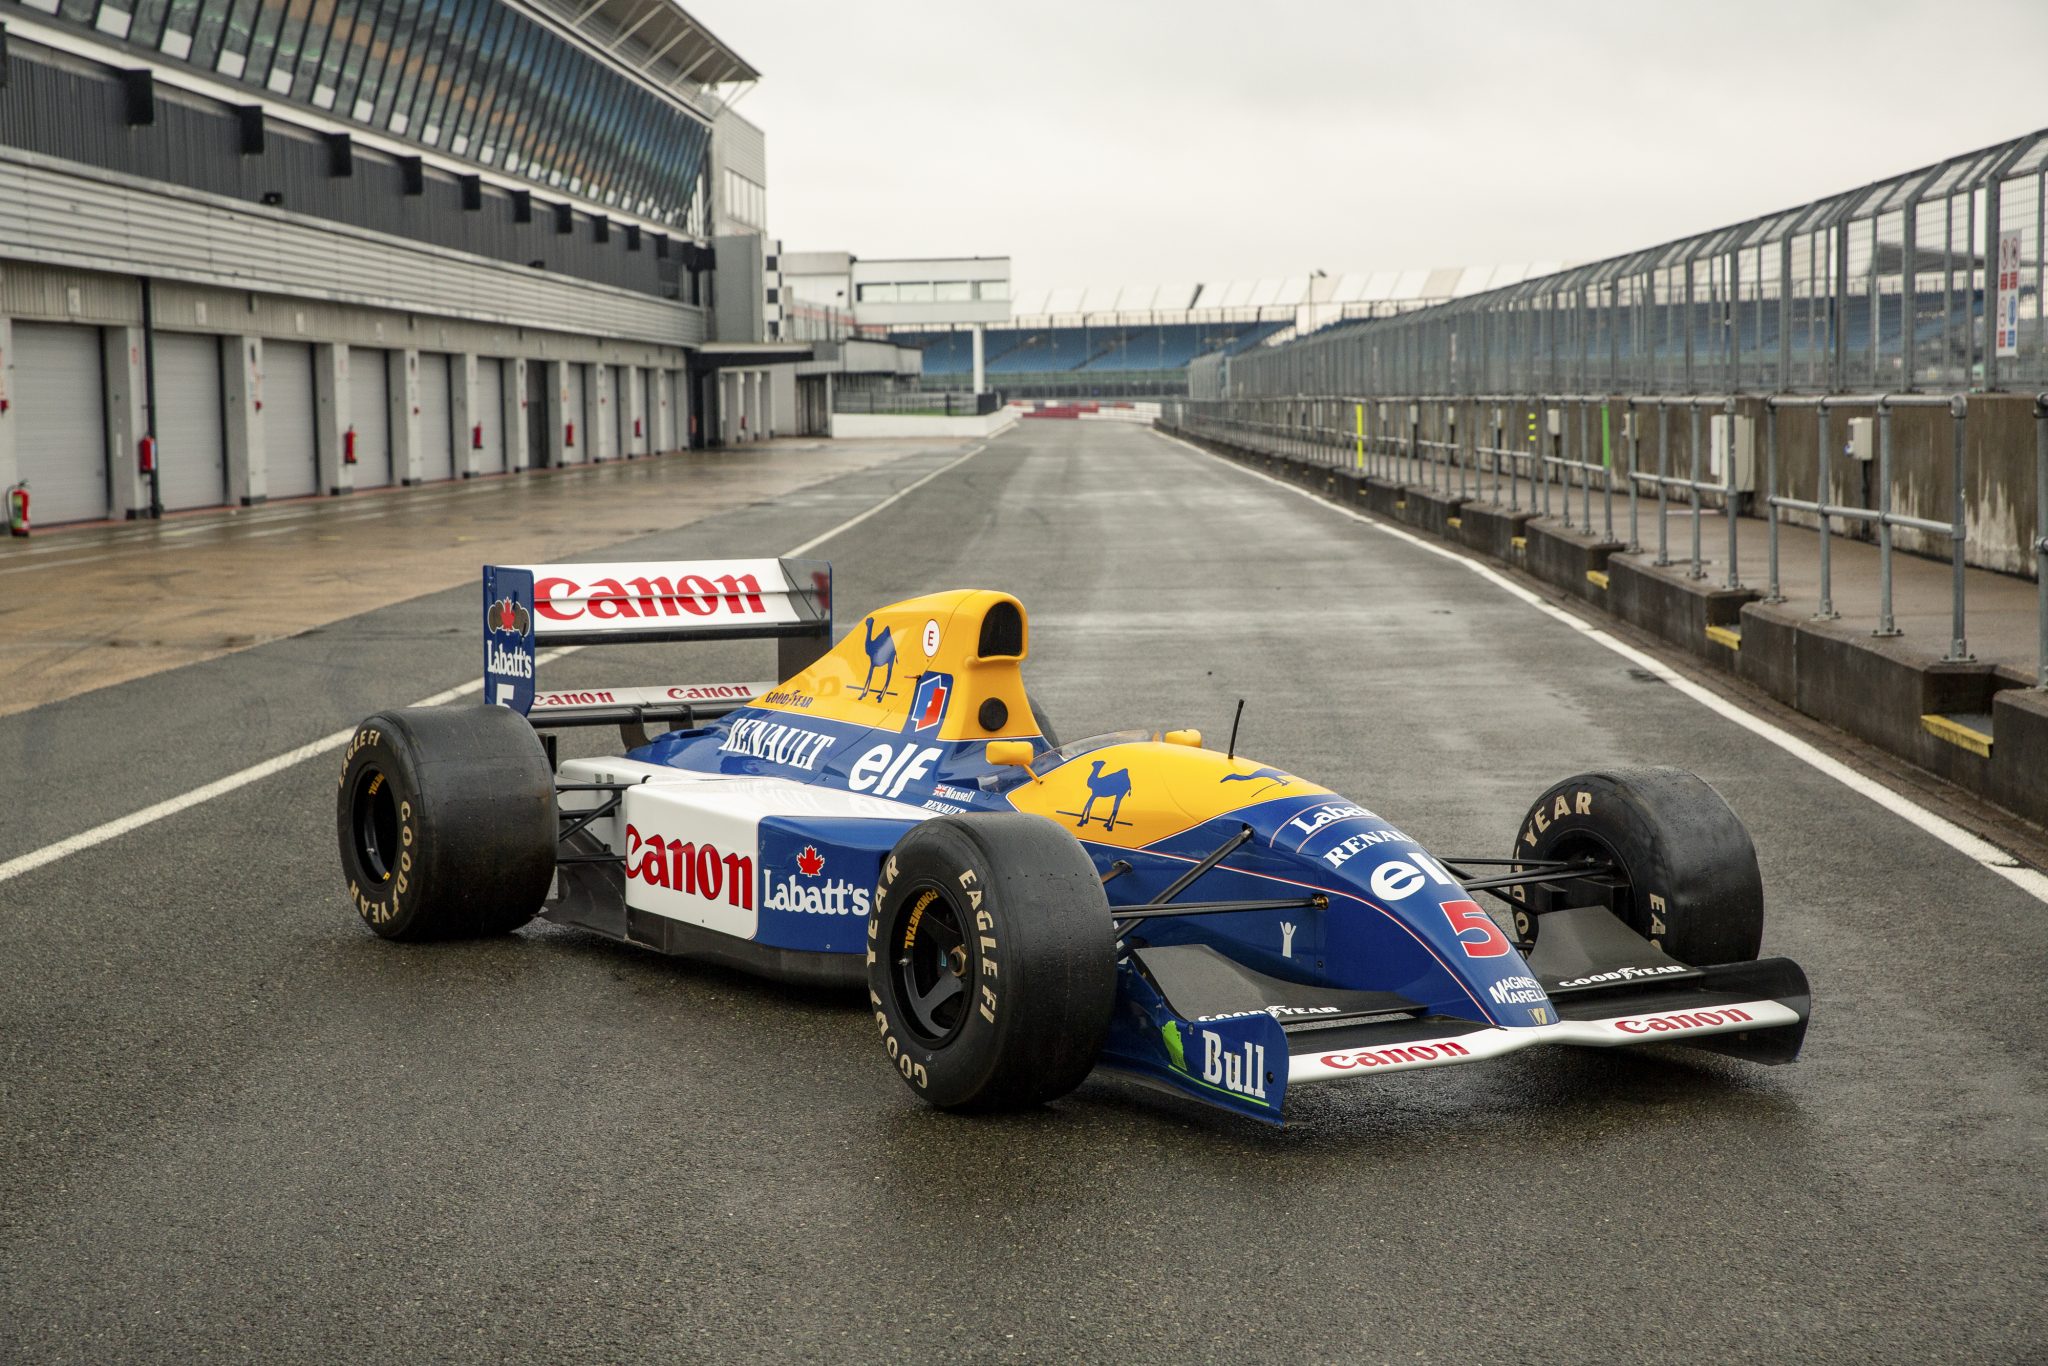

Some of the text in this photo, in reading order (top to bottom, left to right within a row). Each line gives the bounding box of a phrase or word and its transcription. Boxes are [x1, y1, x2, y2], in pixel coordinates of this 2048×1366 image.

[534, 574, 766, 620] Canon
[487, 640, 532, 679] Labatt's
[926, 630, 936, 646] E
[534, 691, 616, 706] Canon
[667, 685, 752, 700] Canon
[718, 718, 836, 771] RENAULT
[848, 743, 943, 798] elf
[944, 786, 976, 802] Mansell
[625, 824, 753, 911] Canon
[1370, 853, 1464, 901] el
[763, 869, 870, 916] Labatt's
[904, 888, 939, 949] FONDMETAL
[958, 869, 998, 979] EAGLE
[1439, 900, 1510, 958] 5
[1614, 1009, 1754, 1033] Canon
[1202, 1029, 1266, 1099] Bull
[1320, 1042, 1470, 1070] Canon
